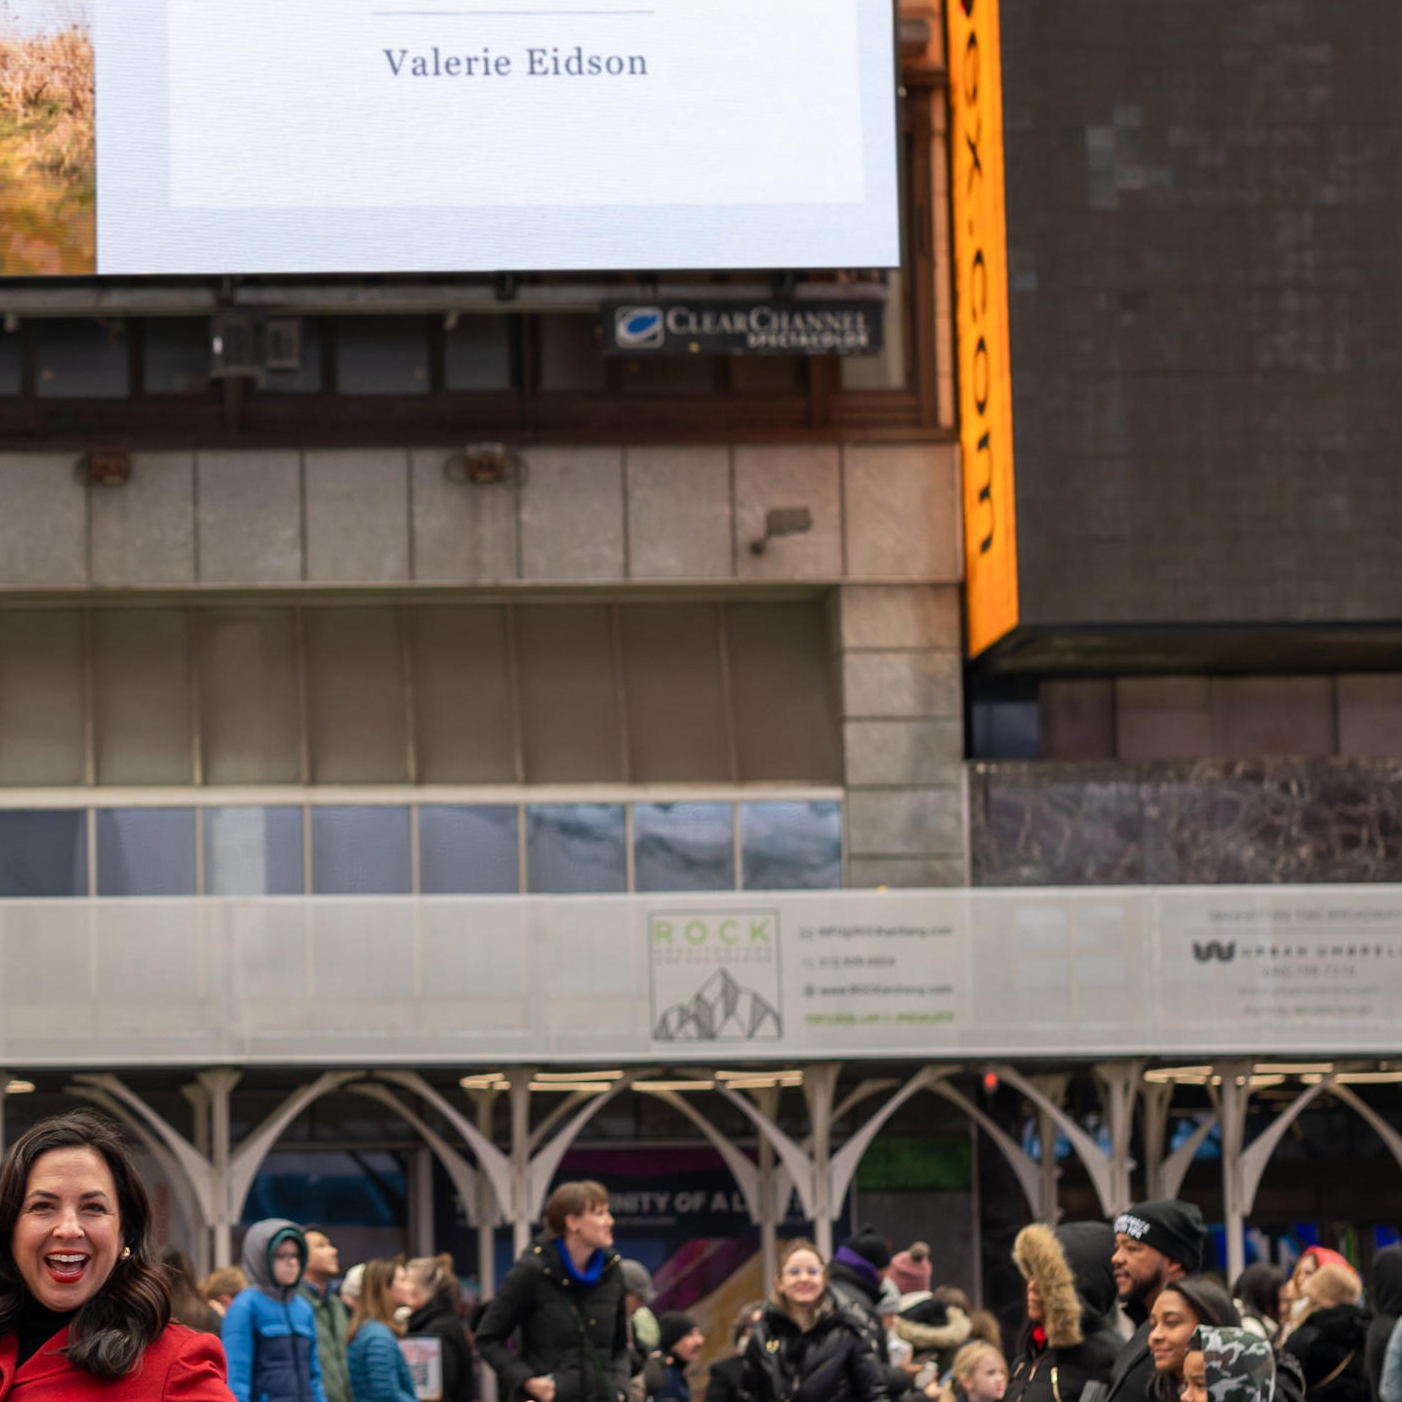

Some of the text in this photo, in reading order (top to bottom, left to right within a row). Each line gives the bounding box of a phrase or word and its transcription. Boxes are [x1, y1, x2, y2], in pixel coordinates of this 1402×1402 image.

[382, 46, 649, 77] Valerie Eidson
[653, 918, 772, 946] ROCK
